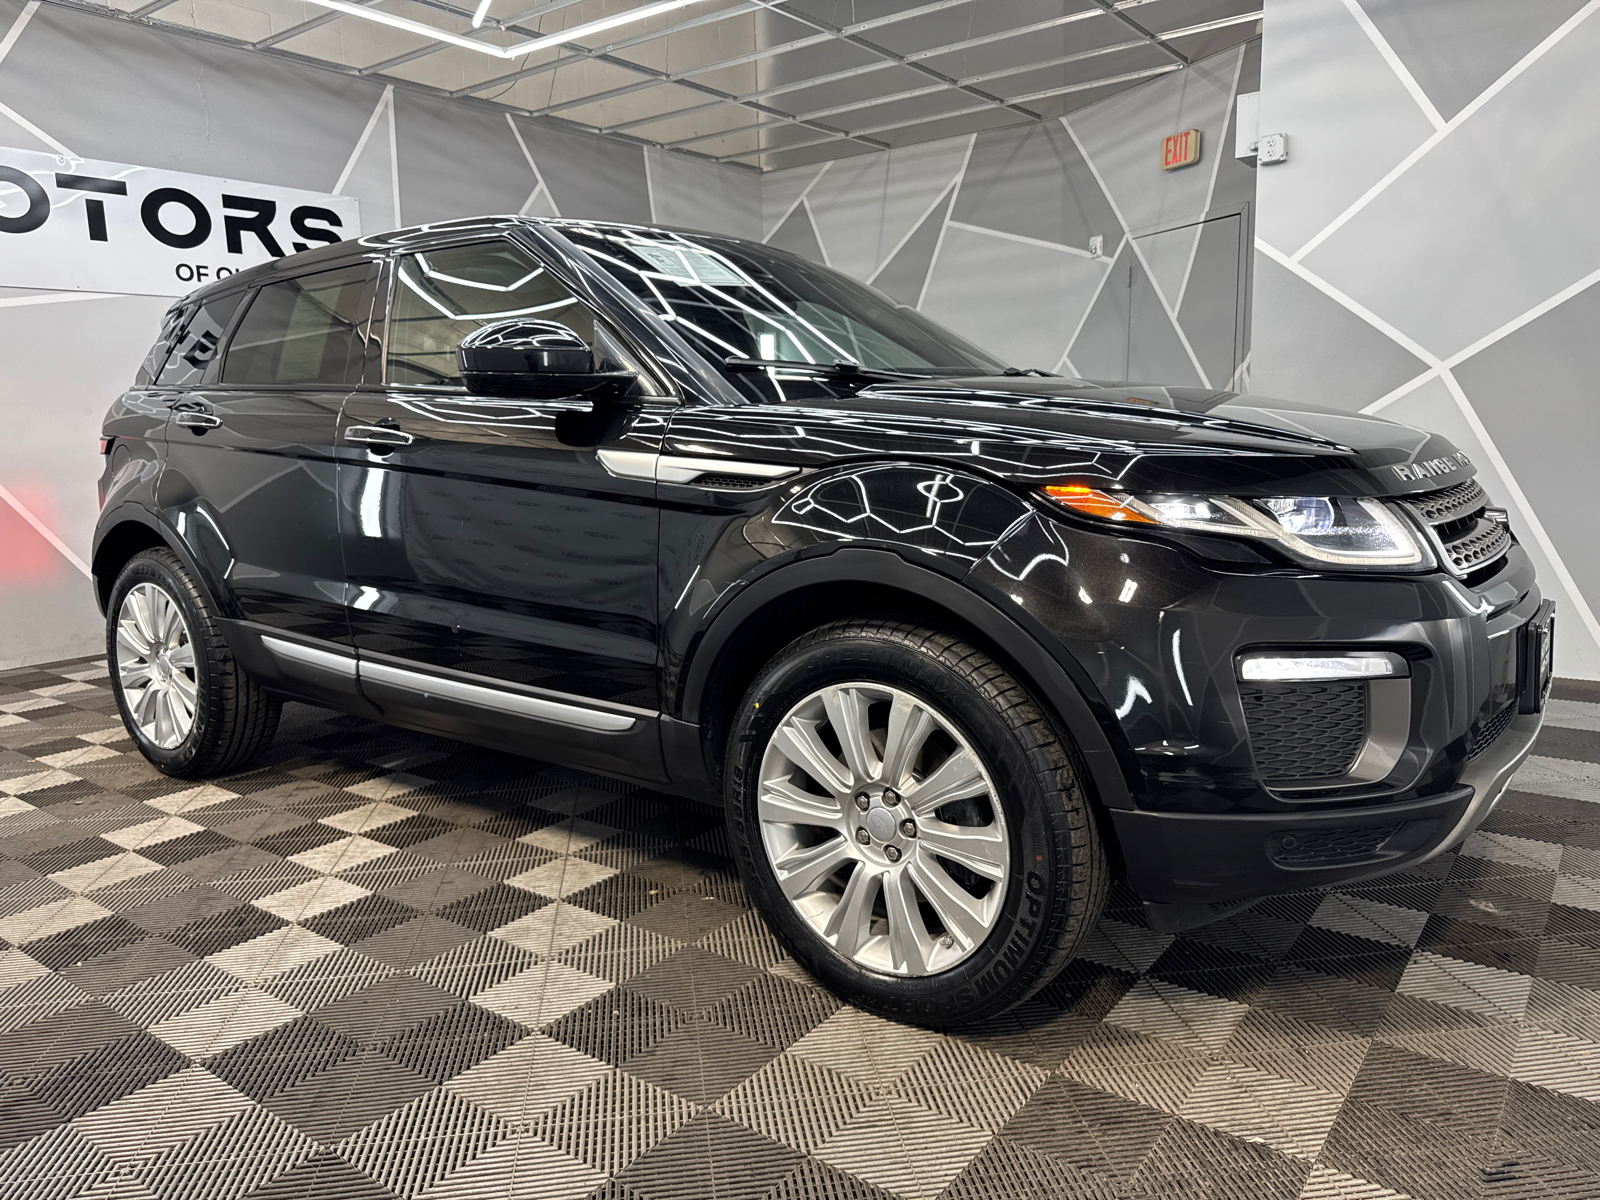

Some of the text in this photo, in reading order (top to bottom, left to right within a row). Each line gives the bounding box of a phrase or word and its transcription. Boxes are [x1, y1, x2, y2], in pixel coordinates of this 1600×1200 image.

[1164, 131, 1190, 167] EXIT
[175, 263, 209, 283] OF
[1391, 456, 1458, 482] RANGE
[973, 869, 1046, 997] OPTIMUM
